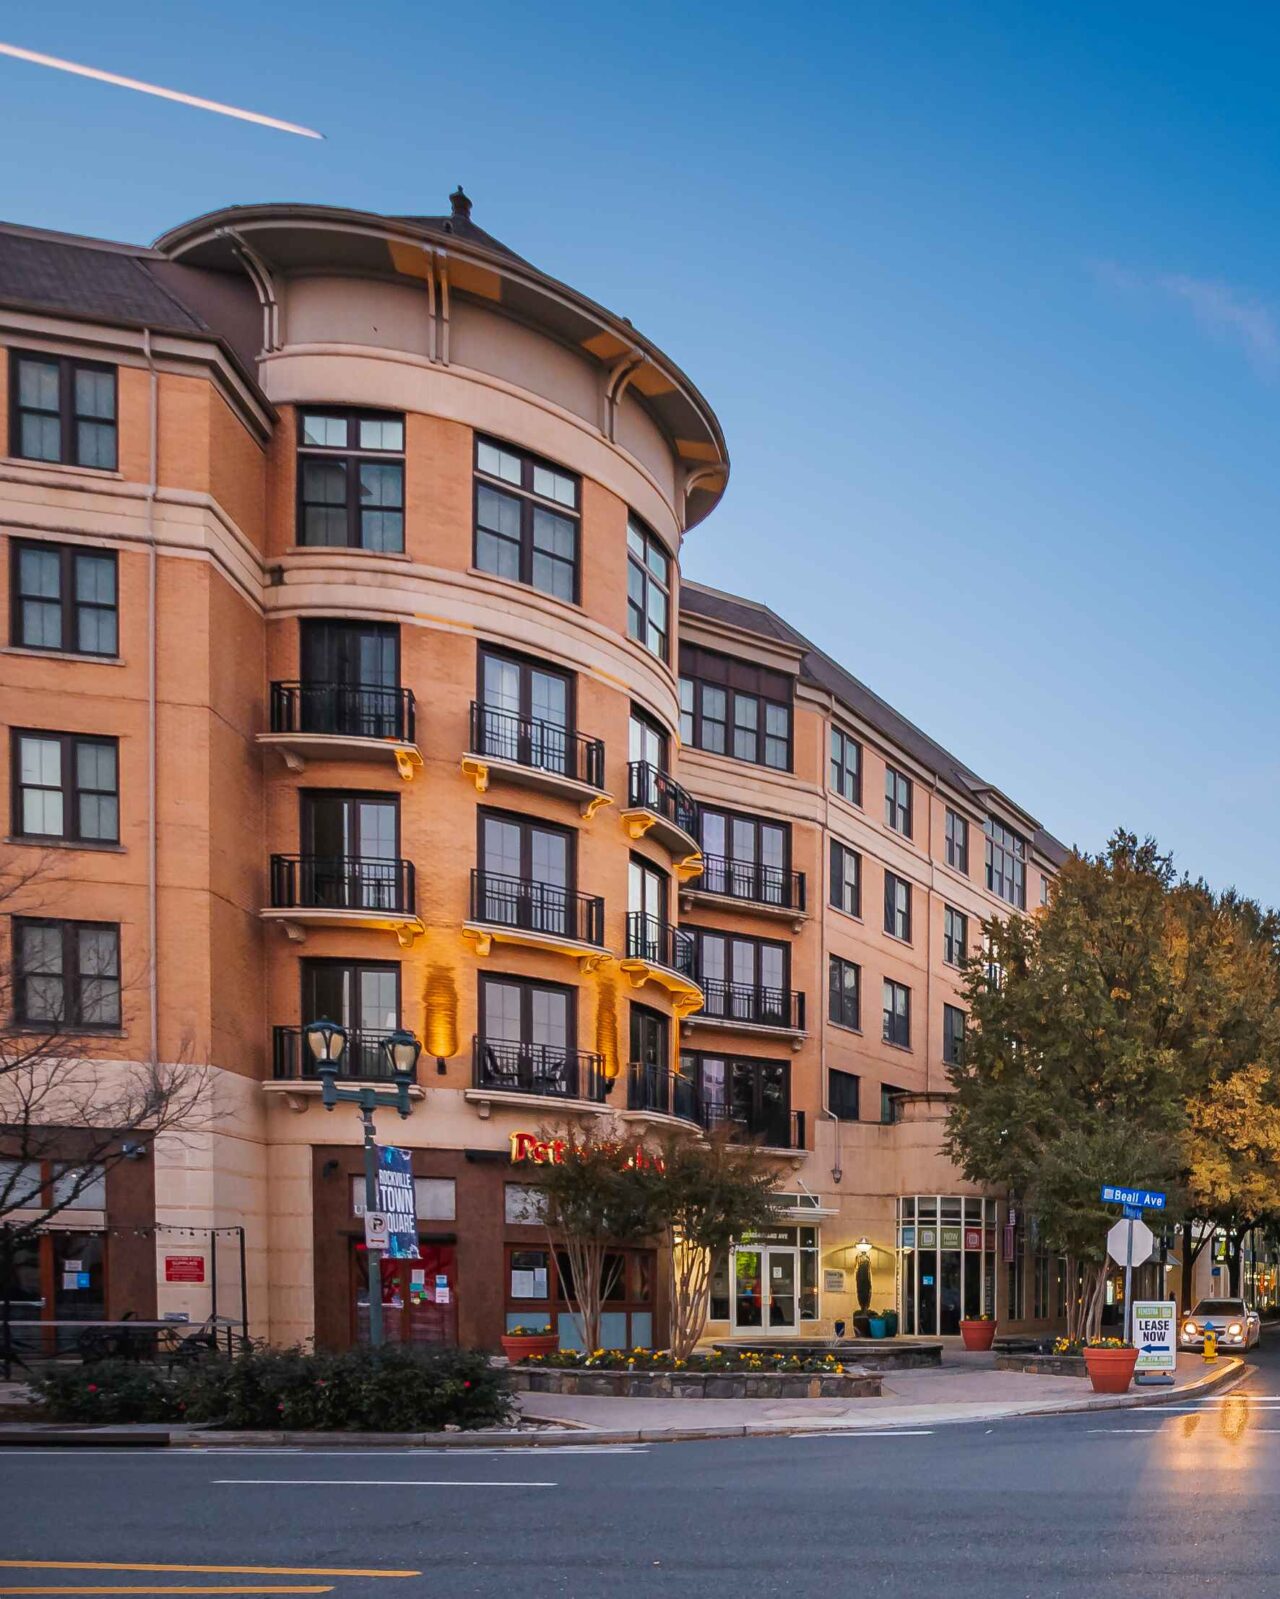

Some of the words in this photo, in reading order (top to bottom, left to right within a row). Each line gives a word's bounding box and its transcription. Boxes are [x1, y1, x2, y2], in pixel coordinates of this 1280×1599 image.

[379, 1169, 412, 1188] ROCKVILLE
[380, 1186, 414, 1213] TOWN
[1114, 1189, 1140, 1204] Beall
[1143, 1193, 1163, 1207] Ave
[387, 1212, 416, 1234] QUARE
[943, 1232, 959, 1240] NOW
[1138, 1320, 1170, 1331] LEASE
[1142, 1331, 1166, 1342] NOW
